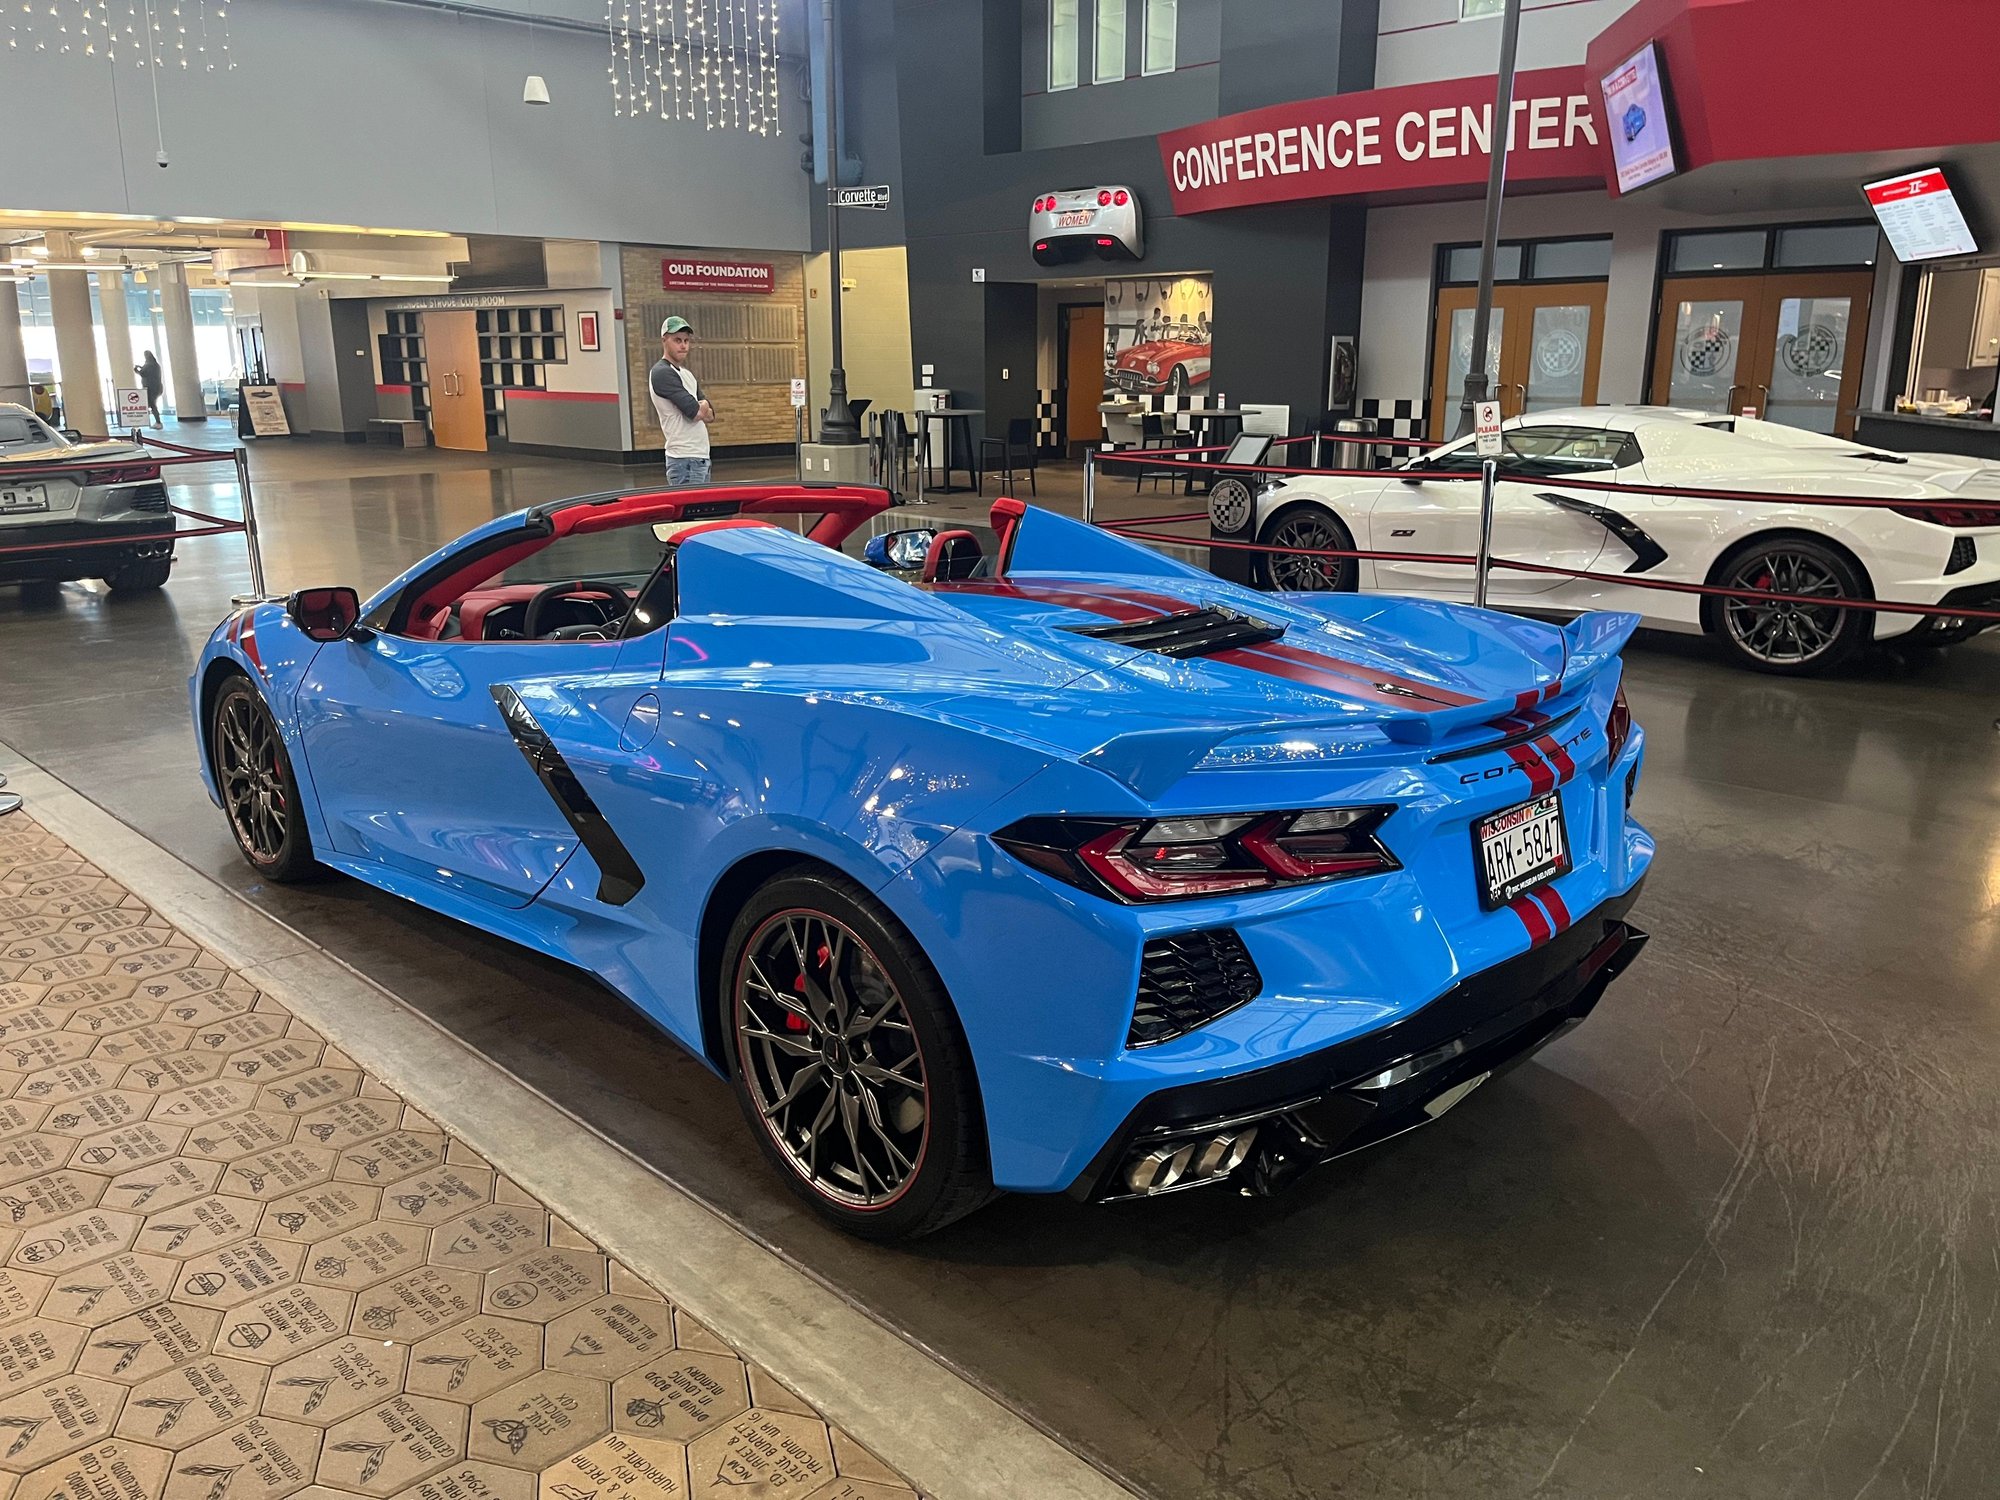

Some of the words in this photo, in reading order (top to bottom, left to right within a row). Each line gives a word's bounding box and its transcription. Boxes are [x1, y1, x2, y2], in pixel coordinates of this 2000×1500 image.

[1172, 116, 1382, 192] CONFERENCE
[1395, 95, 1598, 162] CENTER
[840, 189, 876, 203] Corvette
[1058, 215, 1089, 227] WOMEN
[668, 264, 694, 275] OUR
[697, 265, 768, 278] FOUNDATION
[460, 297, 479, 306] CLUB
[481, 296, 505, 306] ROOM
[1477, 425, 1499, 433] PLEASE
[1459, 727, 1592, 785] CORVETTE
[1481, 808, 1524, 840] WISCONSIN
[1487, 815, 1560, 886] ARK-5847
[242, 1258, 275, 1286] BIRTHDAY
[516, 1261, 542, 1279] GRAY
[547, 1269, 573, 1287] LOUIS
[405, 1276, 422, 1286] TX
[435, 1282, 453, 1294] C3
[566, 1285, 583, 1295] ST
[289, 1286, 306, 1297] ED
[388, 1281, 423, 1308] SANDERS
[543, 1284, 570, 1302] BILLY
[276, 1297, 303, 1319] SILVER
[438, 1306, 455, 1317] FT
[447, 1294, 471, 1311] 1976
[590, 1305, 607, 1316] OF
[137, 1309, 163, 1332] LIGHTS
[154, 1305, 177, 1323] CLUB
[298, 1295, 339, 1333] COLLECTORS
[414, 1306, 441, 1325] WEST
[294, 1317, 318, 1334] 1996
[600, 1314, 641, 1344] MEMORY
[635, 1323, 659, 1339] BILL
[8, 1333, 34, 1358] DREAM
[27, 1329, 48, 1347] IDEA
[153, 1329, 187, 1363] NORTHERN
[167, 1320, 202, 1353] CORVETTE
[284, 1330, 303, 1343] THE
[460, 1327, 499, 1359] RICKETTS
[37, 1345, 57, 1361] HER
[340, 1341, 358, 1354] GS
[499, 1341, 522, 1358] 2015
[635, 1342, 651, 1352] IN
[22, 1356, 41, 1371] HIS
[201, 1361, 228, 1384] JONES
[327, 1354, 358, 1380] NOVELL
[349, 1352, 390, 1387] 10-3-2016
[492, 1357, 514, 1372] JOE
[181, 1364, 213, 1396] MEMORY
[642, 1370, 672, 1392] BOYD
[666, 1370, 702, 1396] LOVING
[682, 1364, 726, 1396] MEMORY
[41, 1385, 59, 1398] OF
[63, 1383, 89, 1409] KEIPER
[219, 1383, 247, 1409] JACKIE
[553, 1391, 580, 1411] COX
[666, 1390, 682, 1400] M
[696, 1394, 714, 1405] IN
[48, 1396, 78, 1430] MEMORY
[204, 1394, 235, 1422] LOVING
[390, 1395, 415, 1415] 2014
[516, 1402, 531, 1412] &
[530, 1392, 574, 1428] VONCILLE
[677, 1398, 710, 1422] DAVID
[79, 1407, 100, 1426] KEN
[376, 1407, 407, 1433] MARIA
[524, 1410, 557, 1436] STEVE
[745, 1411, 763, 1423] 16
[67, 1428, 85, 1440] IN
[244, 1418, 269, 1439] 2016
[399, 1432, 415, 1442] &
[406, 1412, 457, 1459] GENDELMAN
[758, 1421, 781, 1437] WA
[230, 1431, 257, 1454] JOAN
[602, 1435, 627, 1453] WV
[724, 1435, 741, 1446] &
[732, 1421, 778, 1457] BURNETT
[99, 1443, 119, 1459] CO
[247, 1452, 263, 1463] &
[260, 1436, 305, 1483] HEINEMANN
[406, 1440, 435, 1463] JOHN
[735, 1444, 770, 1471] JANET
[775, 1435, 828, 1474] TACOMA,
[78, 1450, 103, 1475] CLUB
[569, 1452, 610, 1486] PREMA
[726, 1458, 753, 1480] NCM
[772, 1455, 809, 1482] STEVE
[255, 1461, 282, 1486] DAVE
[457, 1468, 492, 1498] #2945
[609, 1462, 638, 1485] RAY
[604, 1482, 621, 1493] &
[837, 1484, 855, 1497] IL
